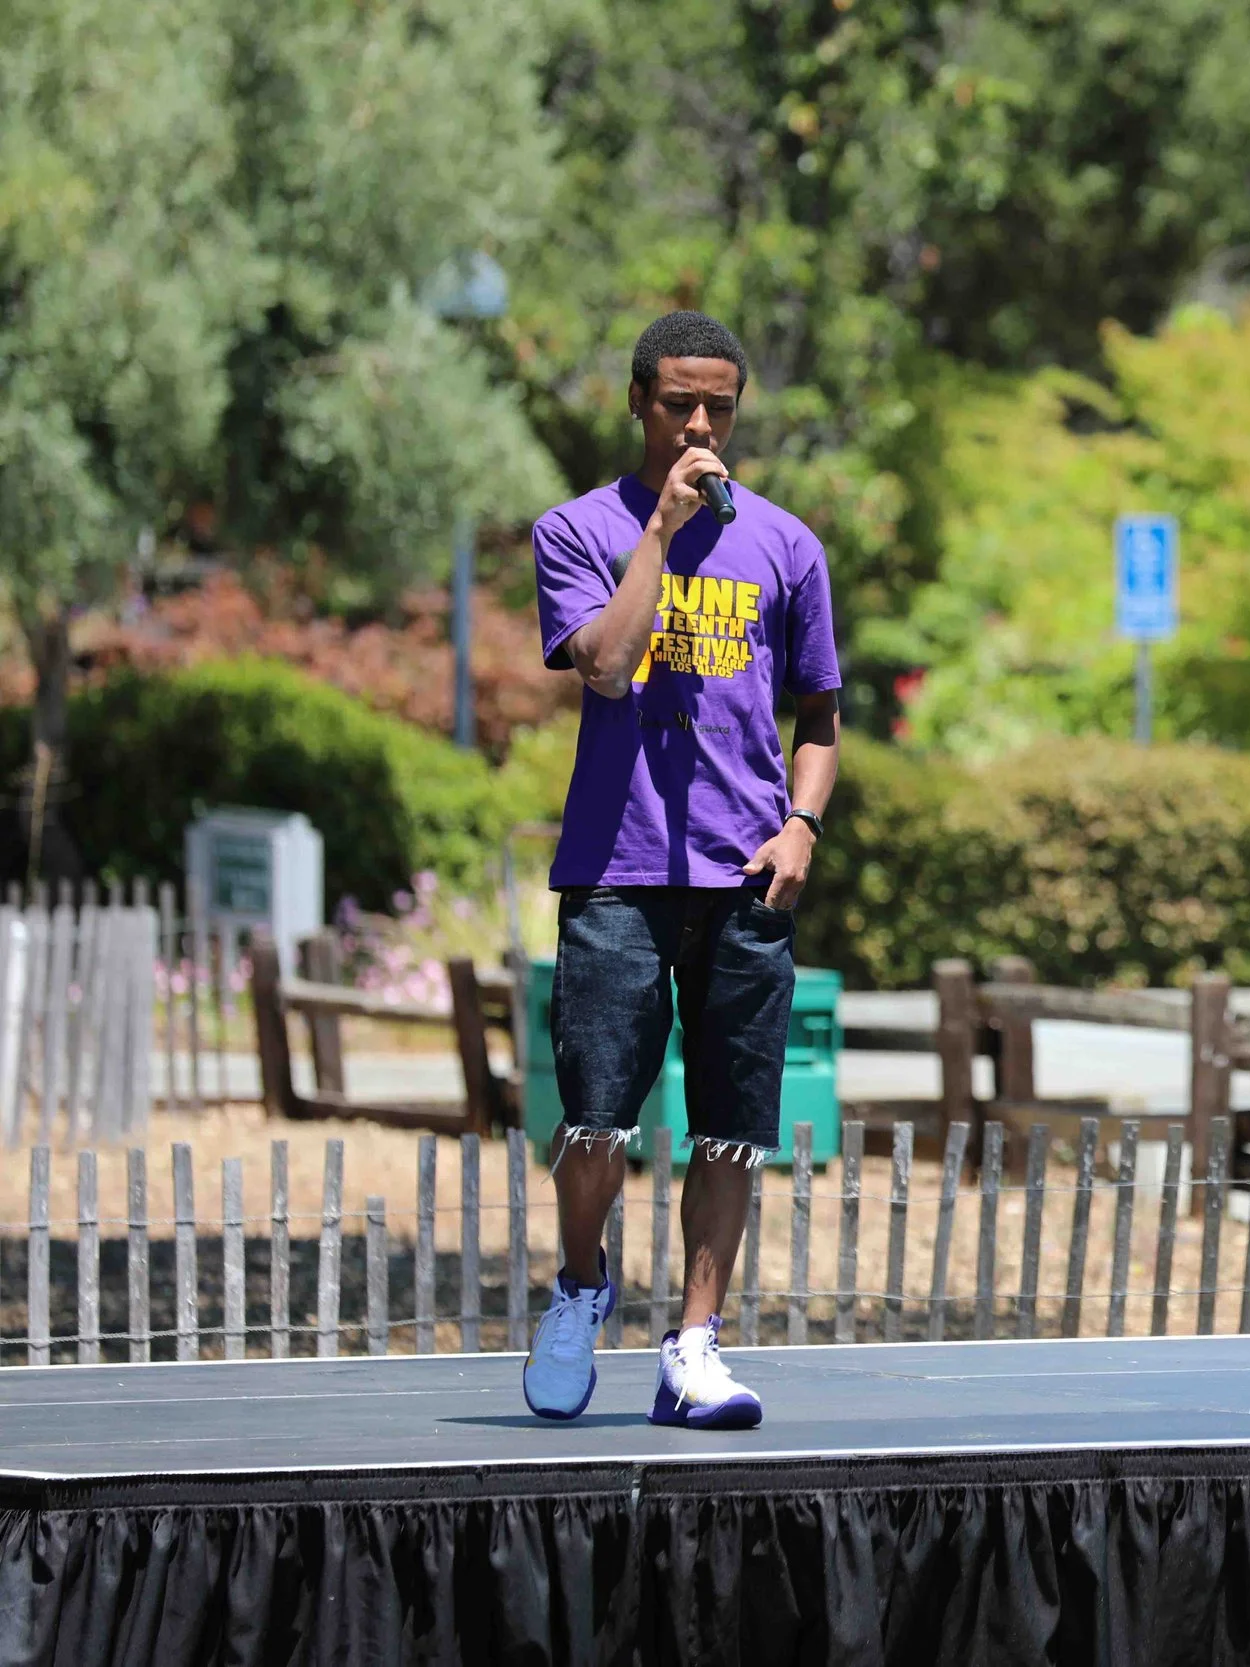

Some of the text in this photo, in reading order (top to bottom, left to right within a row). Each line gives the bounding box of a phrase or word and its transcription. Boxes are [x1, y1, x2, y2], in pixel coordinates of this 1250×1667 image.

[656, 573, 761, 621] JUNE
[659, 610, 745, 638] TEENTH
[650, 632, 753, 662] FESTIVAL
[653, 650, 747, 672] HILLVIEW PARK
[670, 661, 734, 678] LOS ALTOS
